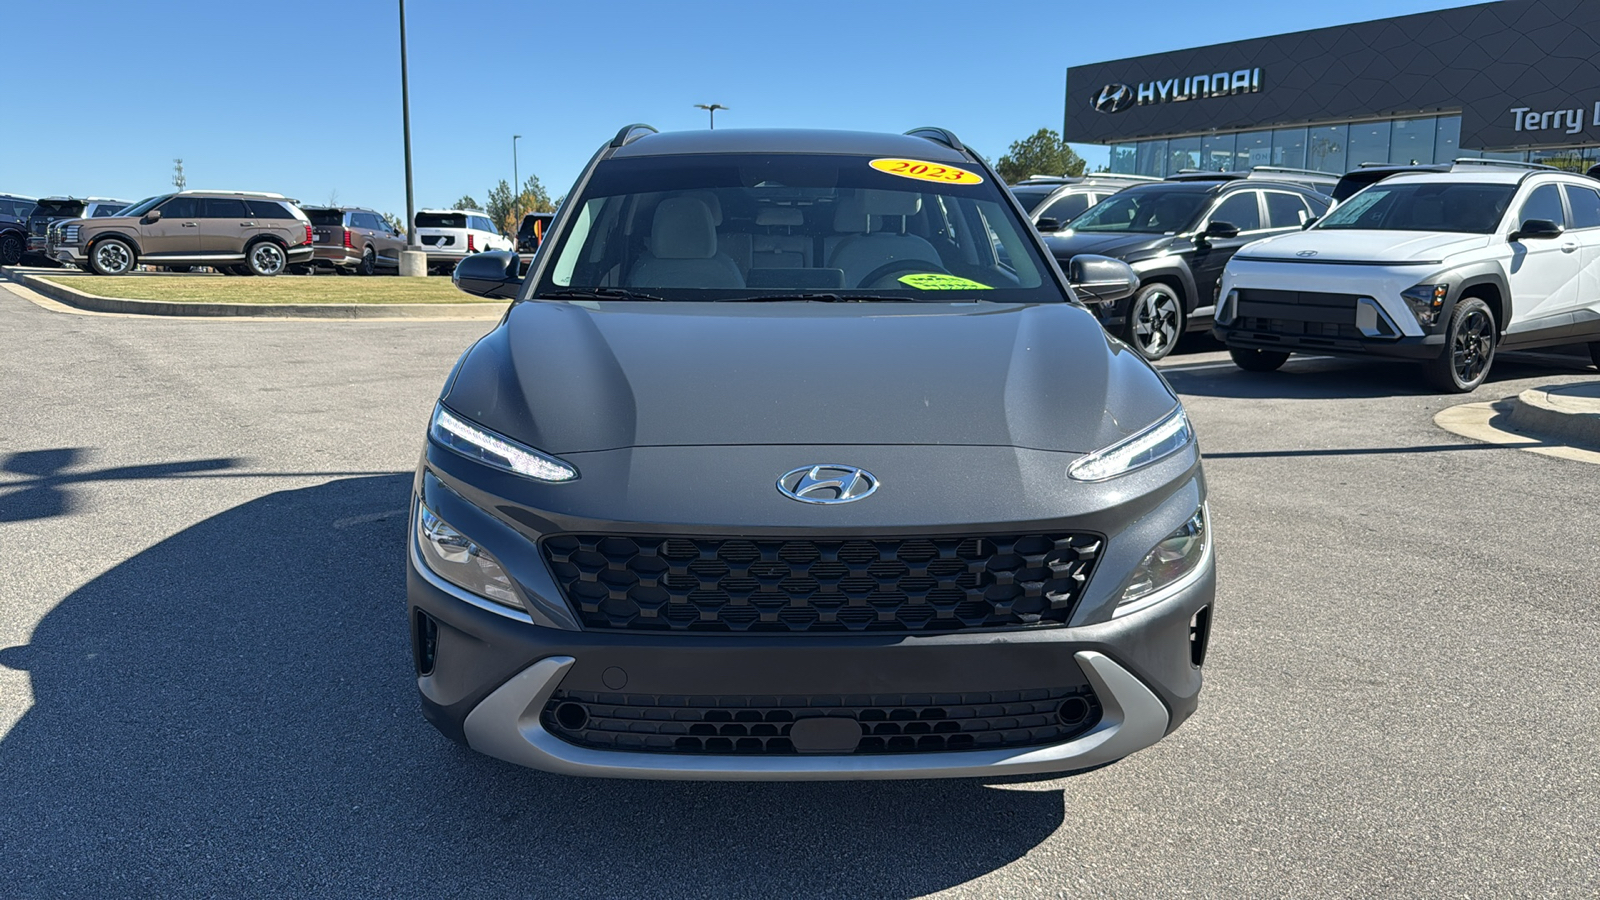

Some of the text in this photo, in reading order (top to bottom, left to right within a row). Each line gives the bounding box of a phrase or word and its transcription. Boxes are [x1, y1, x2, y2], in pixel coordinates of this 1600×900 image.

[1137, 67, 1263, 106] HYUNDAI
[1510, 107, 1584, 134] Terry
[889, 162, 965, 180] 2023
